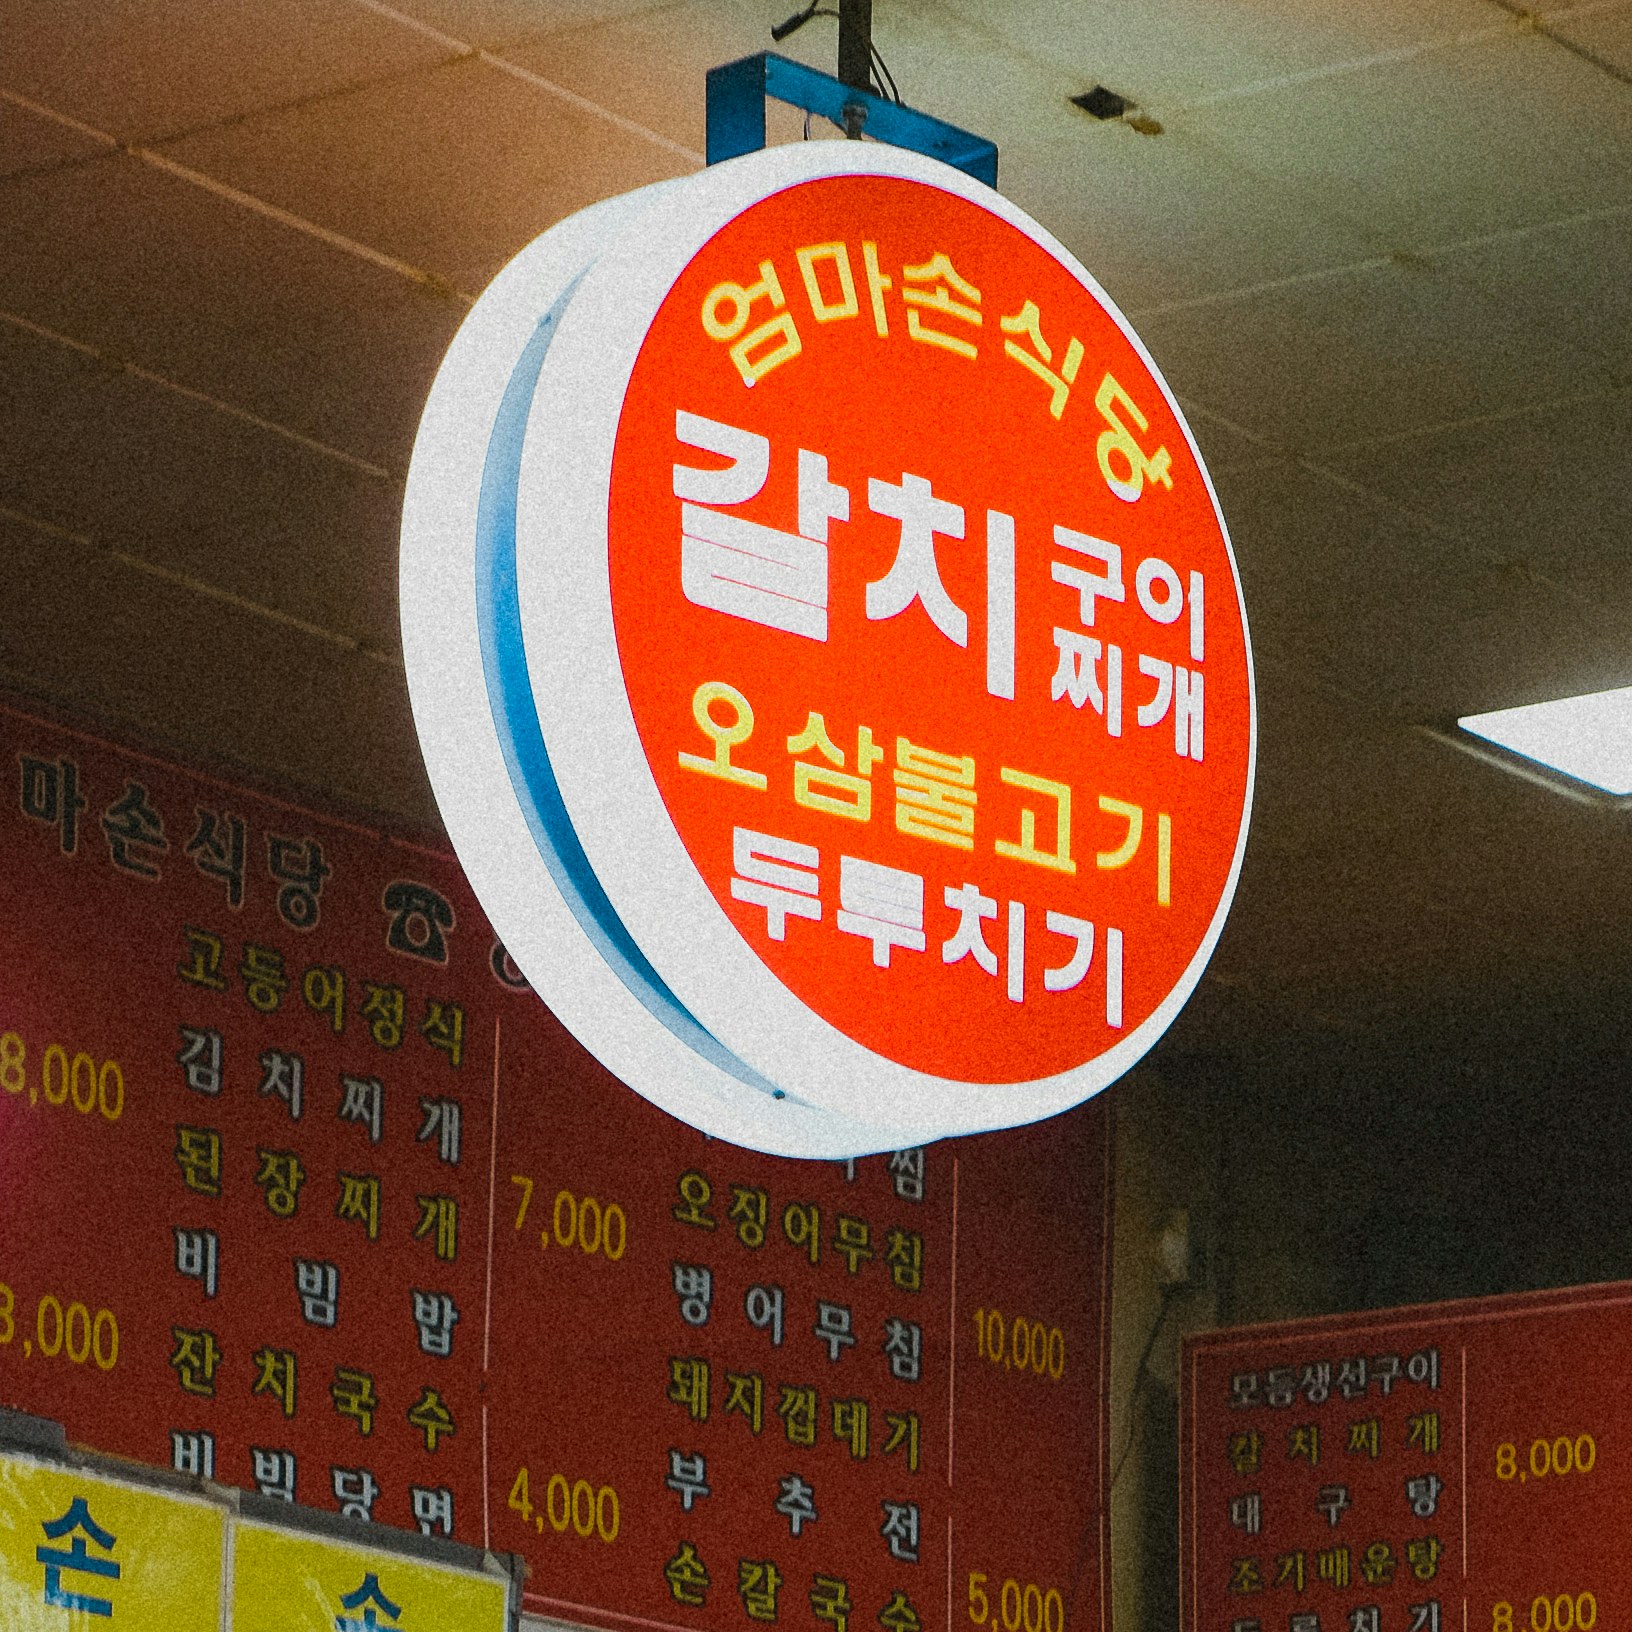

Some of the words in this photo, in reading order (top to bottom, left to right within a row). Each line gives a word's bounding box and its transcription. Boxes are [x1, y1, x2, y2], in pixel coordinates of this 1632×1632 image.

[701, 239, 1174, 503] 엄마손식당
[673, 408, 1018, 701] 갈치
[1051, 524, 1206, 661] 구이
[1051, 630, 1206, 763] 찌개
[19, 755, 332, 930] 마손식당
[678, 680, 1174, 908] 오삼불고기
[730, 826, 1126, 1029] 두루치기
[179, 924, 466, 1067] 고등어정식
[0, 1031, 124, 1120] 8,000
[178, 1025, 461, 1164] 김치찌개
[175, 1125, 458, 1261] 된장찌개
[511, 1176, 626, 1260] 7,000
[673, 1171, 922, 1292] 오징어무침
[174, 1227, 458, 1357] 비빔밥
[672, 1262, 922, 1381] 병어무침
[974, 1308, 1065, 1380] 10,000
[170, 1327, 455, 1452] 잔치국수
[669, 1356, 921, 1472] 돼지껍데기
[1230, 1349, 1441, 1407] 모듬생선구이
[508, 1467, 620, 1542] 4,000
[666, 1450, 920, 1563] 부추전
[1231, 1474, 1442, 1536] 대구탕
[1495, 1434, 1597, 1483] 8,000
[1228, 1536, 1442, 1596] 조기매운탕
